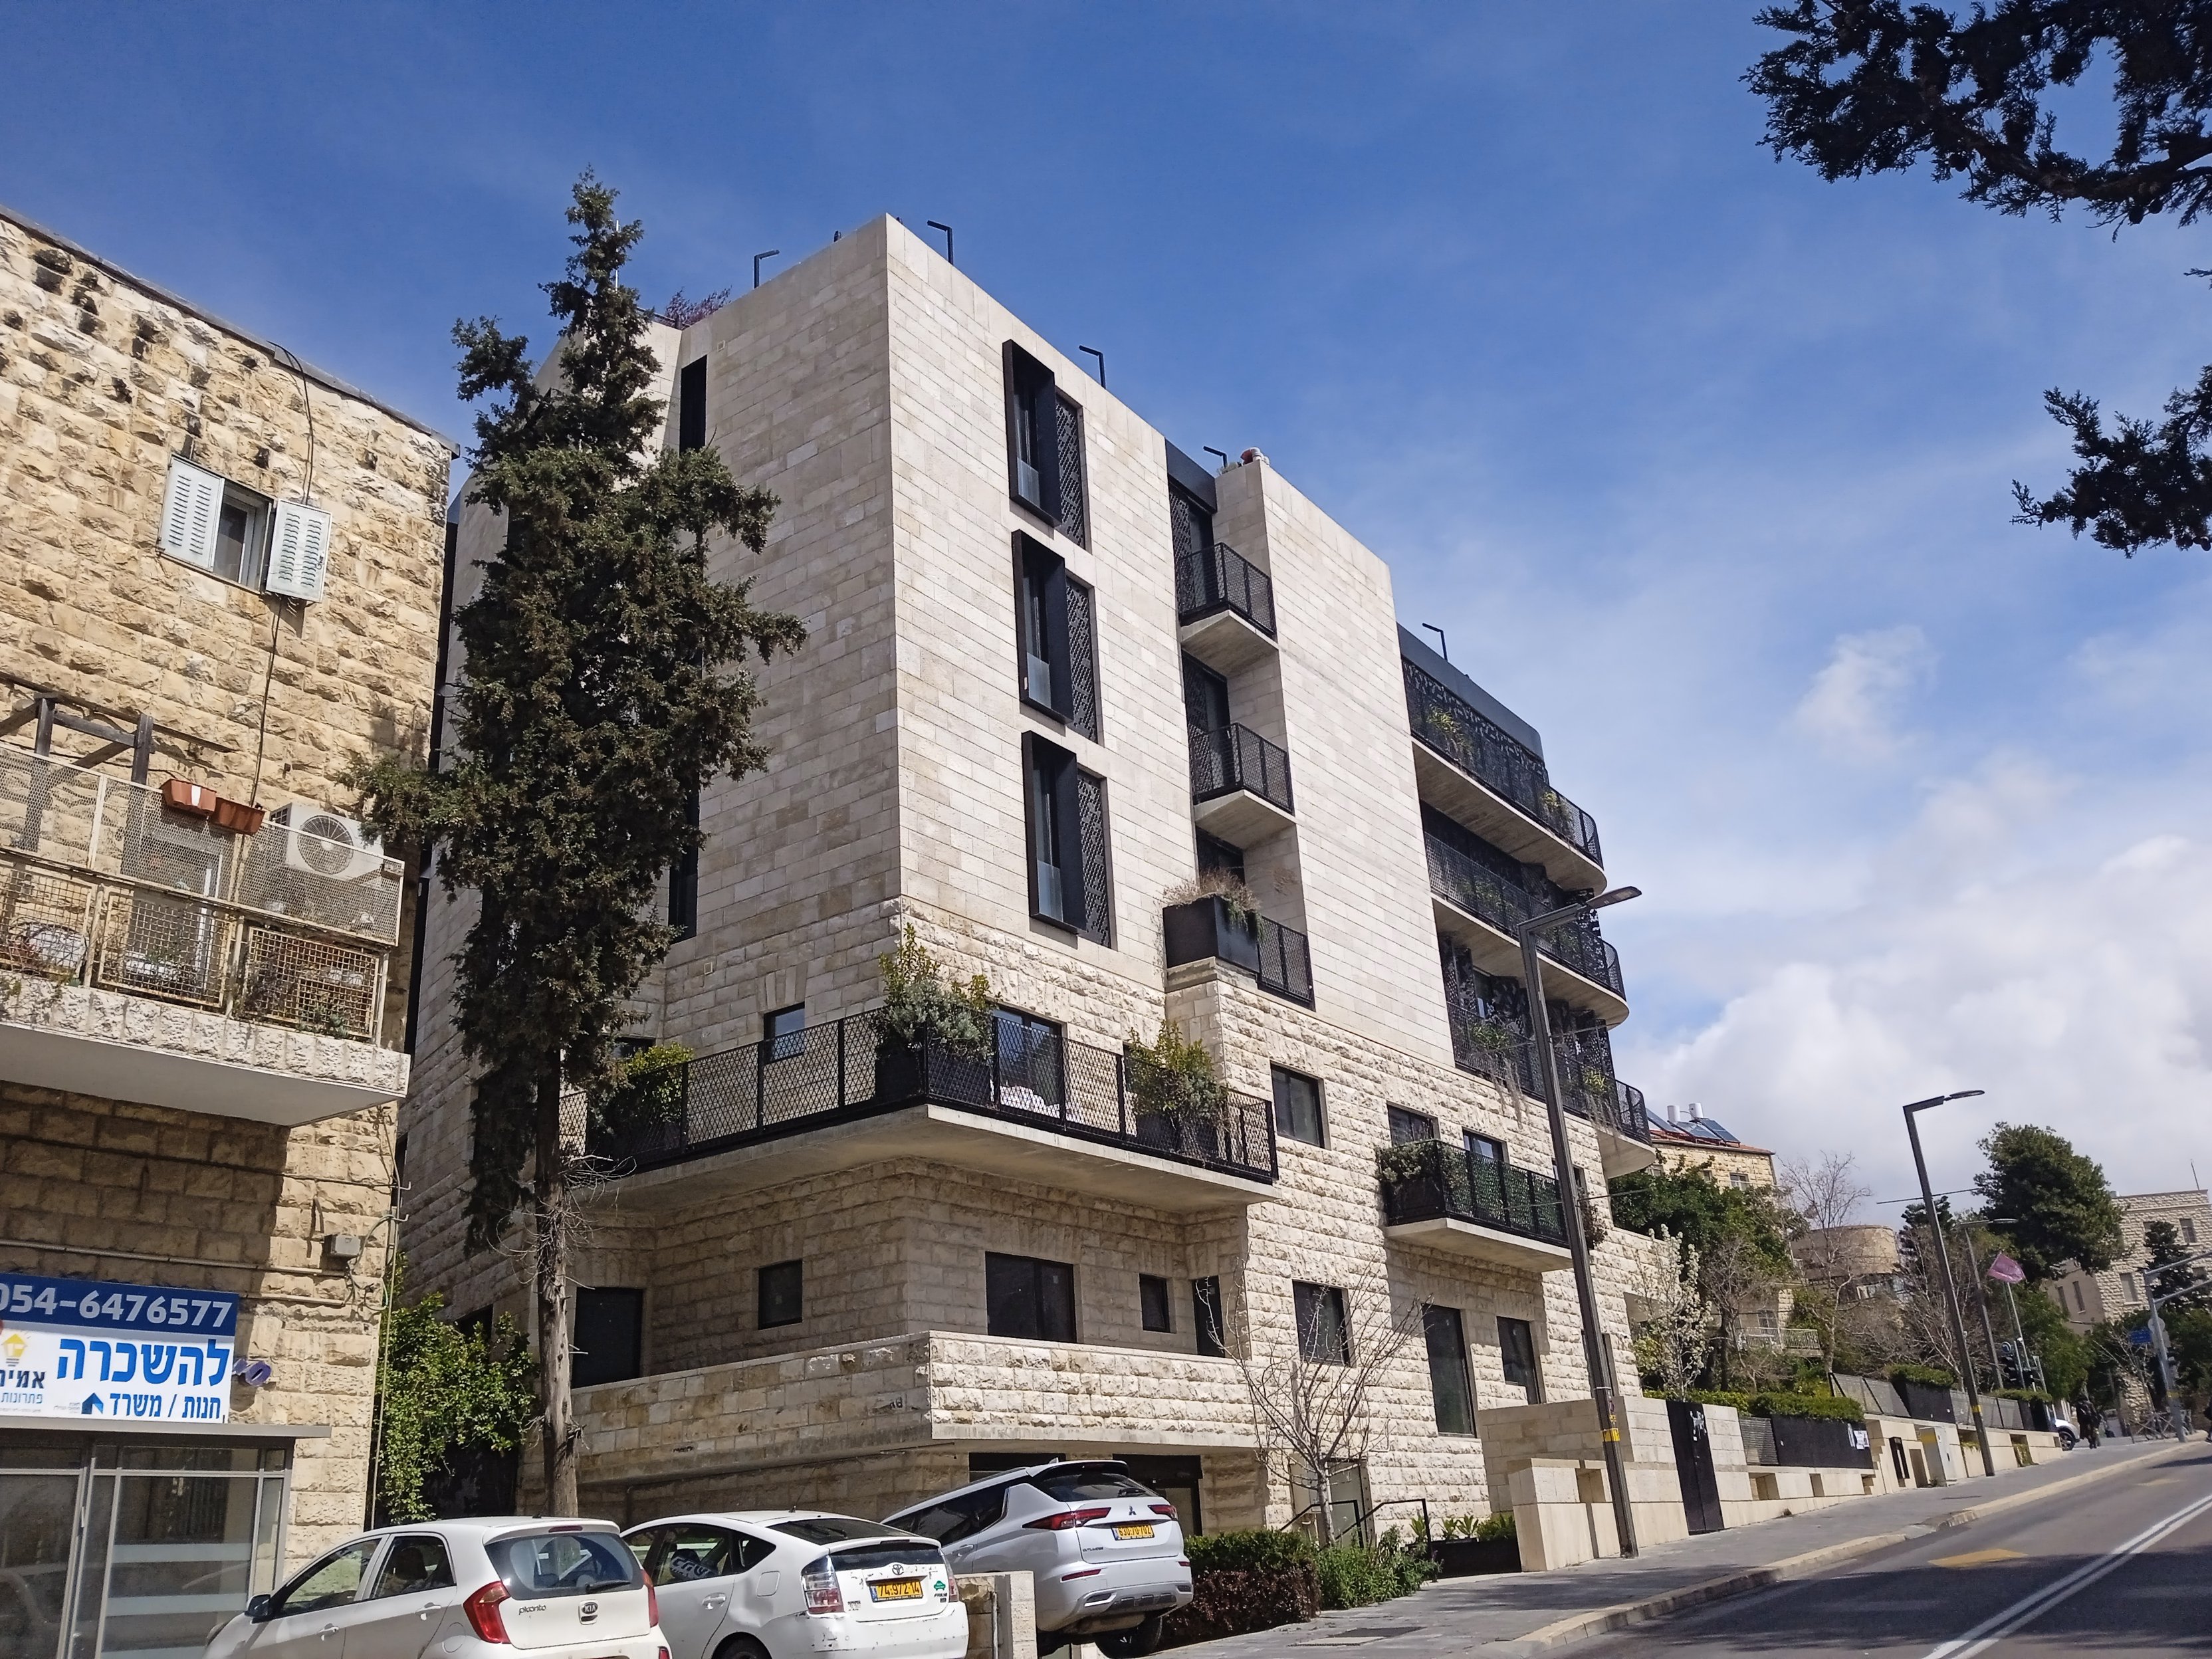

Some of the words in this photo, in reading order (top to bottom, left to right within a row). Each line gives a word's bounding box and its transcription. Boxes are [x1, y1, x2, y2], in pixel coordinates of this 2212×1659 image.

[57, 1339, 230, 1386] להשכרה
[1, 1392, 43, 1404] פתרונות
[110, 1392, 162, 1417] משרד
[181, 1396, 221, 1419] חנות
[518, 1604, 546, 1615] picanto
